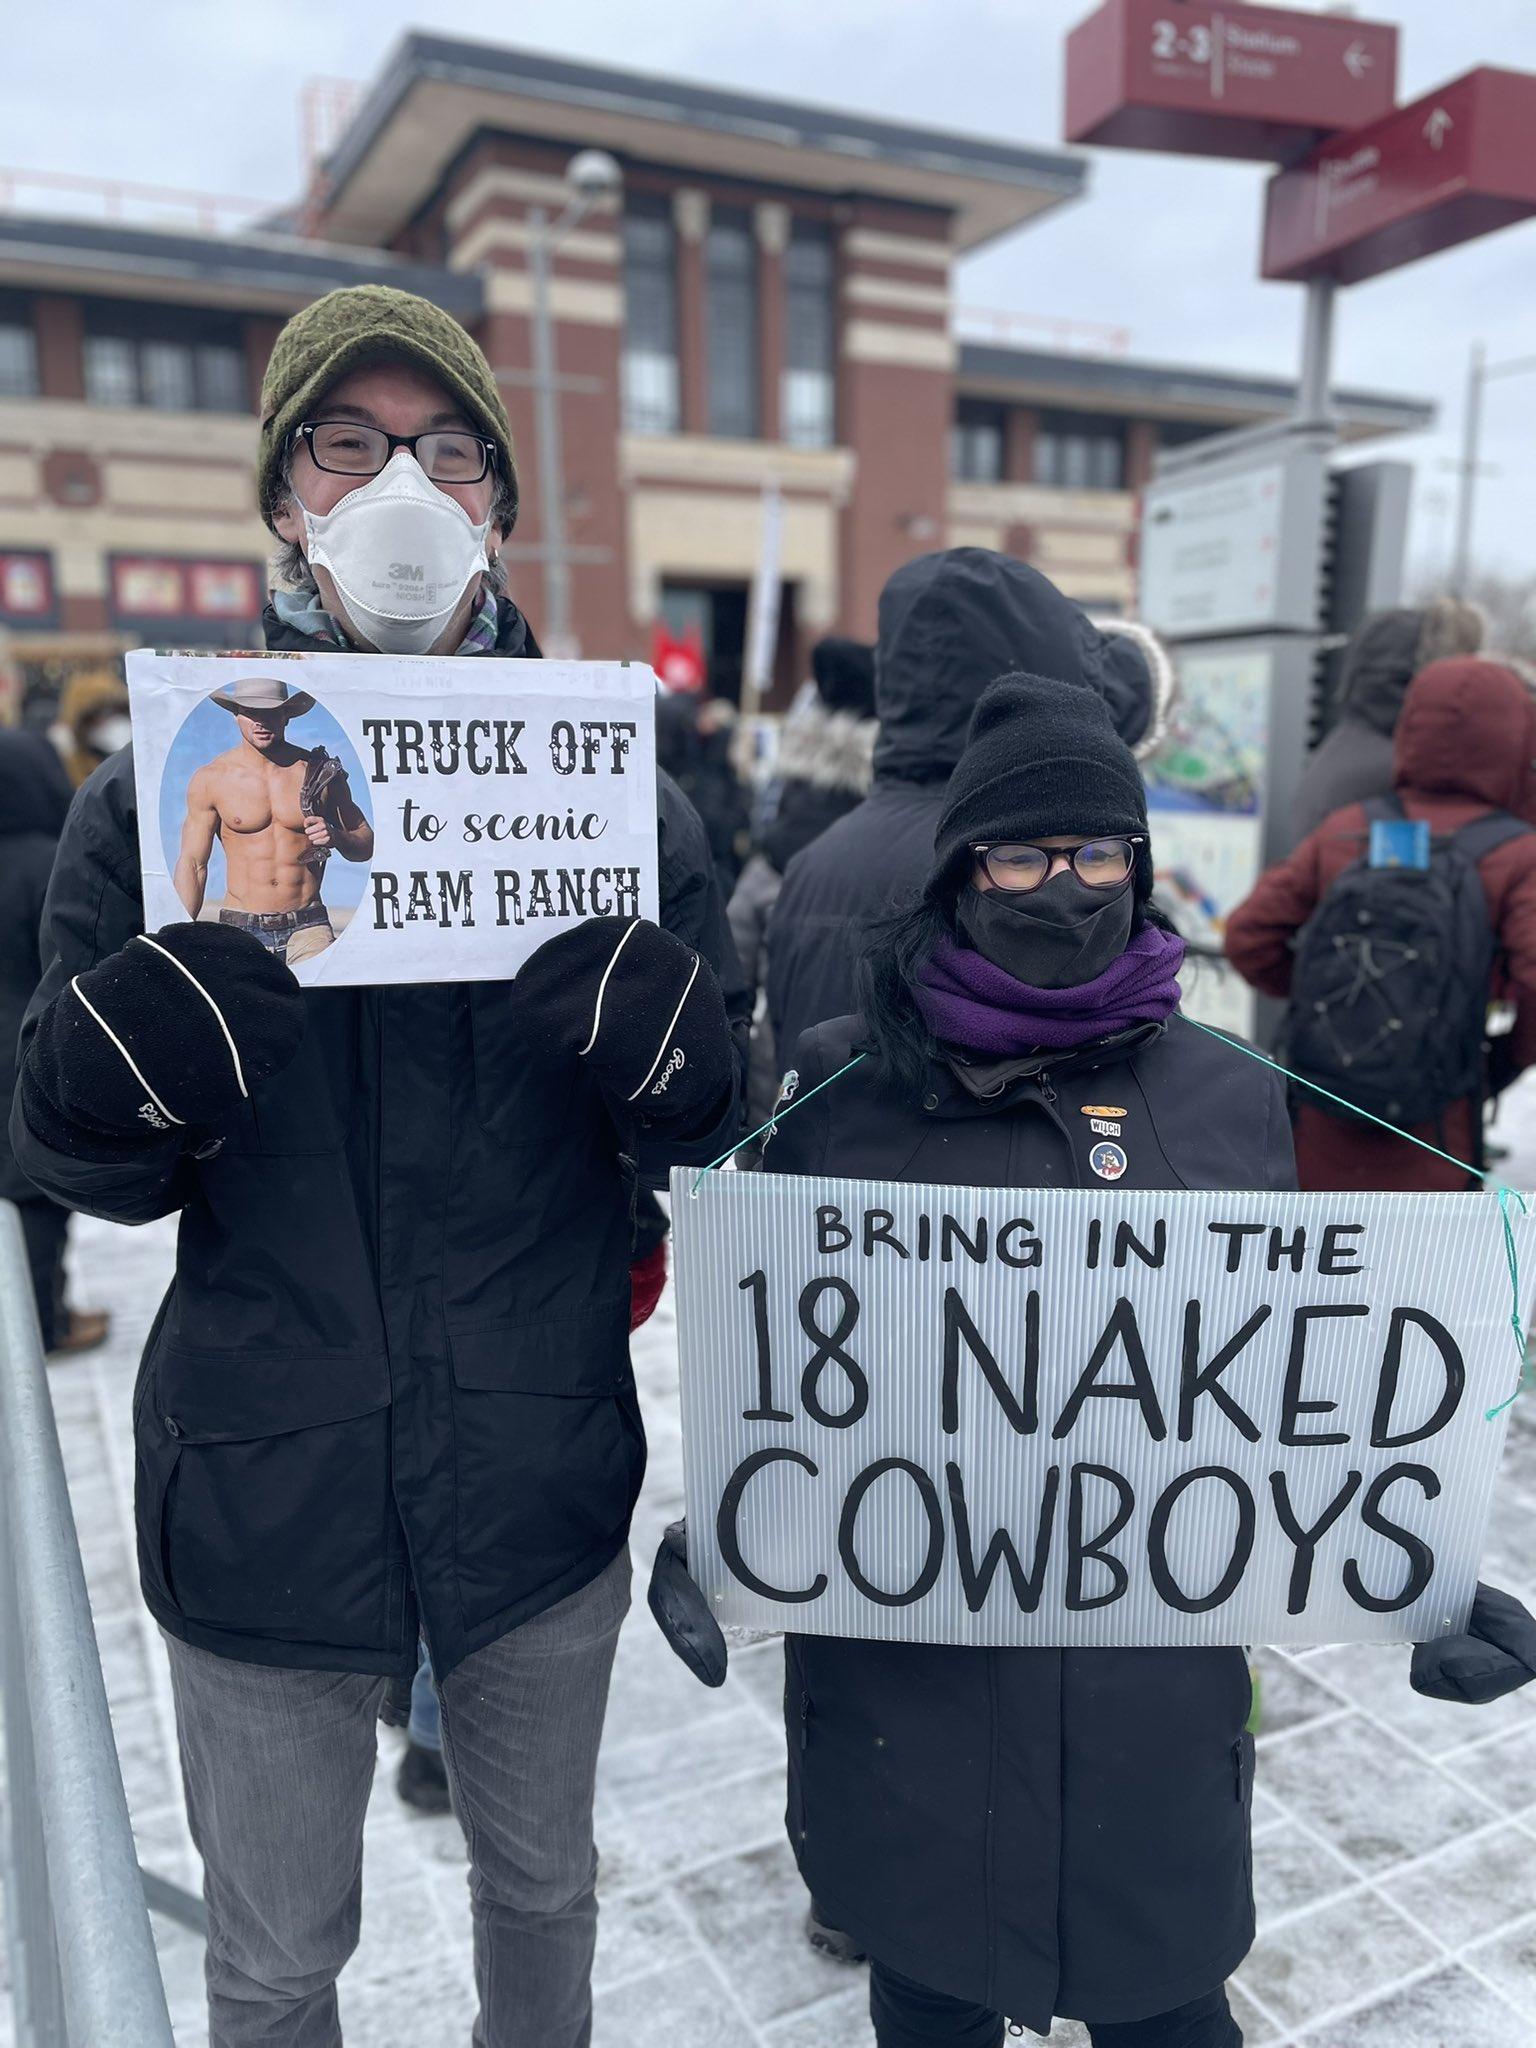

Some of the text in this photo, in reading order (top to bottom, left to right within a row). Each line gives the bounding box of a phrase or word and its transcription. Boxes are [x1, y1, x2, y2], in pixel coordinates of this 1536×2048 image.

[1152, 19, 1211, 63] 2-3
[388, 562, 424, 581] 3M
[363, 719, 636, 783] TRUCK OFF
[398, 798, 608, 843] to scenic
[371, 867, 642, 930] RAM RANCH
[815, 1205, 1366, 1275] BRING IN THE
[738, 1269, 1465, 1448] 18 NAKED
[717, 1447, 1441, 1615] COWBOYS
